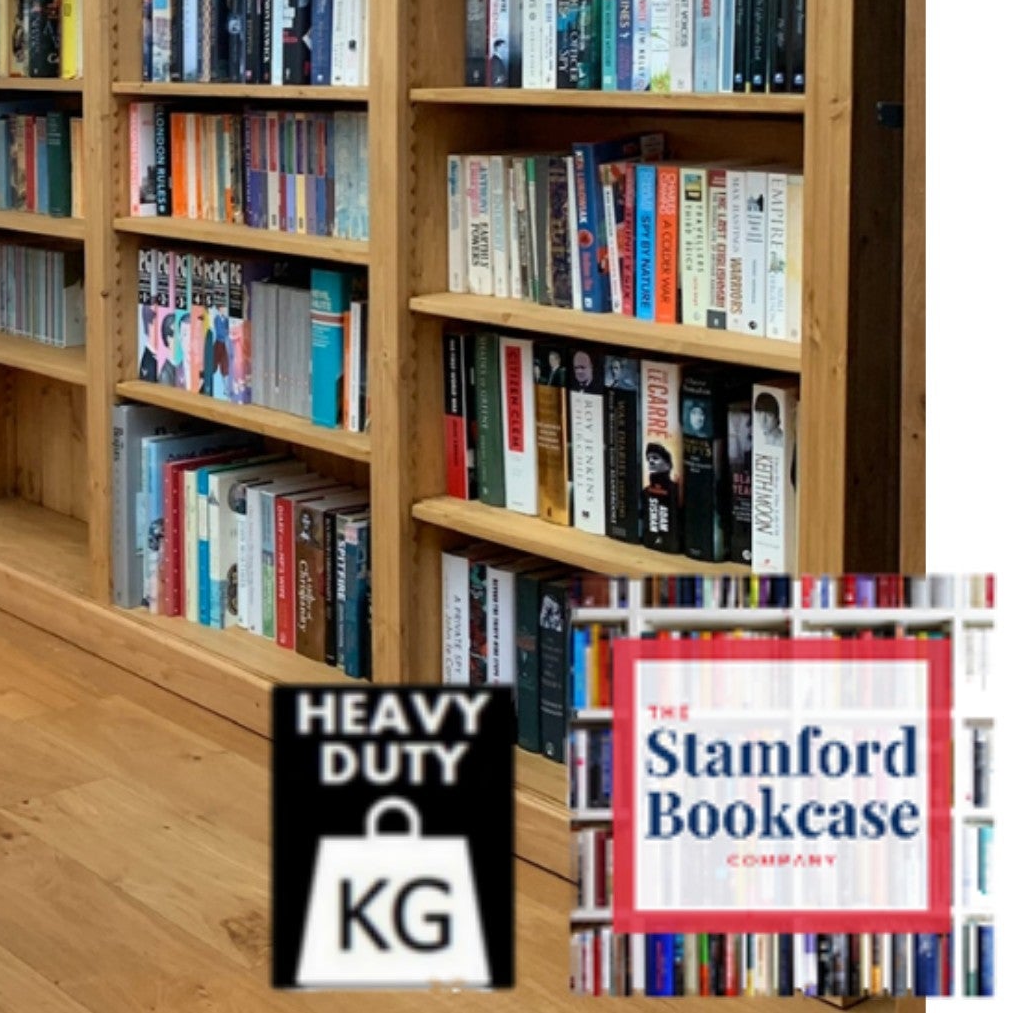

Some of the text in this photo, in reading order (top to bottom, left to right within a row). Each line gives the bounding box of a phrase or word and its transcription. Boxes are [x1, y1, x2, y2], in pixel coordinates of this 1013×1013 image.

[156, 111, 167, 204] LONDON RULES
[684, 204, 692, 272] THIRD REICH
[695, 204, 705, 274] TRAVELLERS
[715, 212, 727, 240] LAST
[769, 177, 785, 252] EMPIRE
[470, 222, 480, 268] POWERS
[479, 221, 490, 269] EARTHLY
[640, 214, 652, 309] SPY BY NATURE
[661, 230, 672, 275] COLDER
[660, 276, 670, 305] WAR
[715, 242, 728, 309] ENGLISHMAN
[729, 256, 743, 316] WARRIORS
[507, 350, 521, 449] CITIZEN CLEM
[647, 384, 673, 441] CARRÉ
[584, 399, 596, 504] ROY JENKINS
[276, 504, 284, 534] DIARY
[648, 497, 661, 533] SISMAN
[658, 504, 669, 533] ADAM
[753, 453, 774, 536] KEITH MOON
[278, 575, 286, 599] WIFE
[297, 558, 311, 633] Christianity
[336, 539, 346, 602] SPITFIRE
[445, 613, 454, 640] John
[453, 607, 462, 649] PRIVATE
[453, 653, 462, 674] SPY
